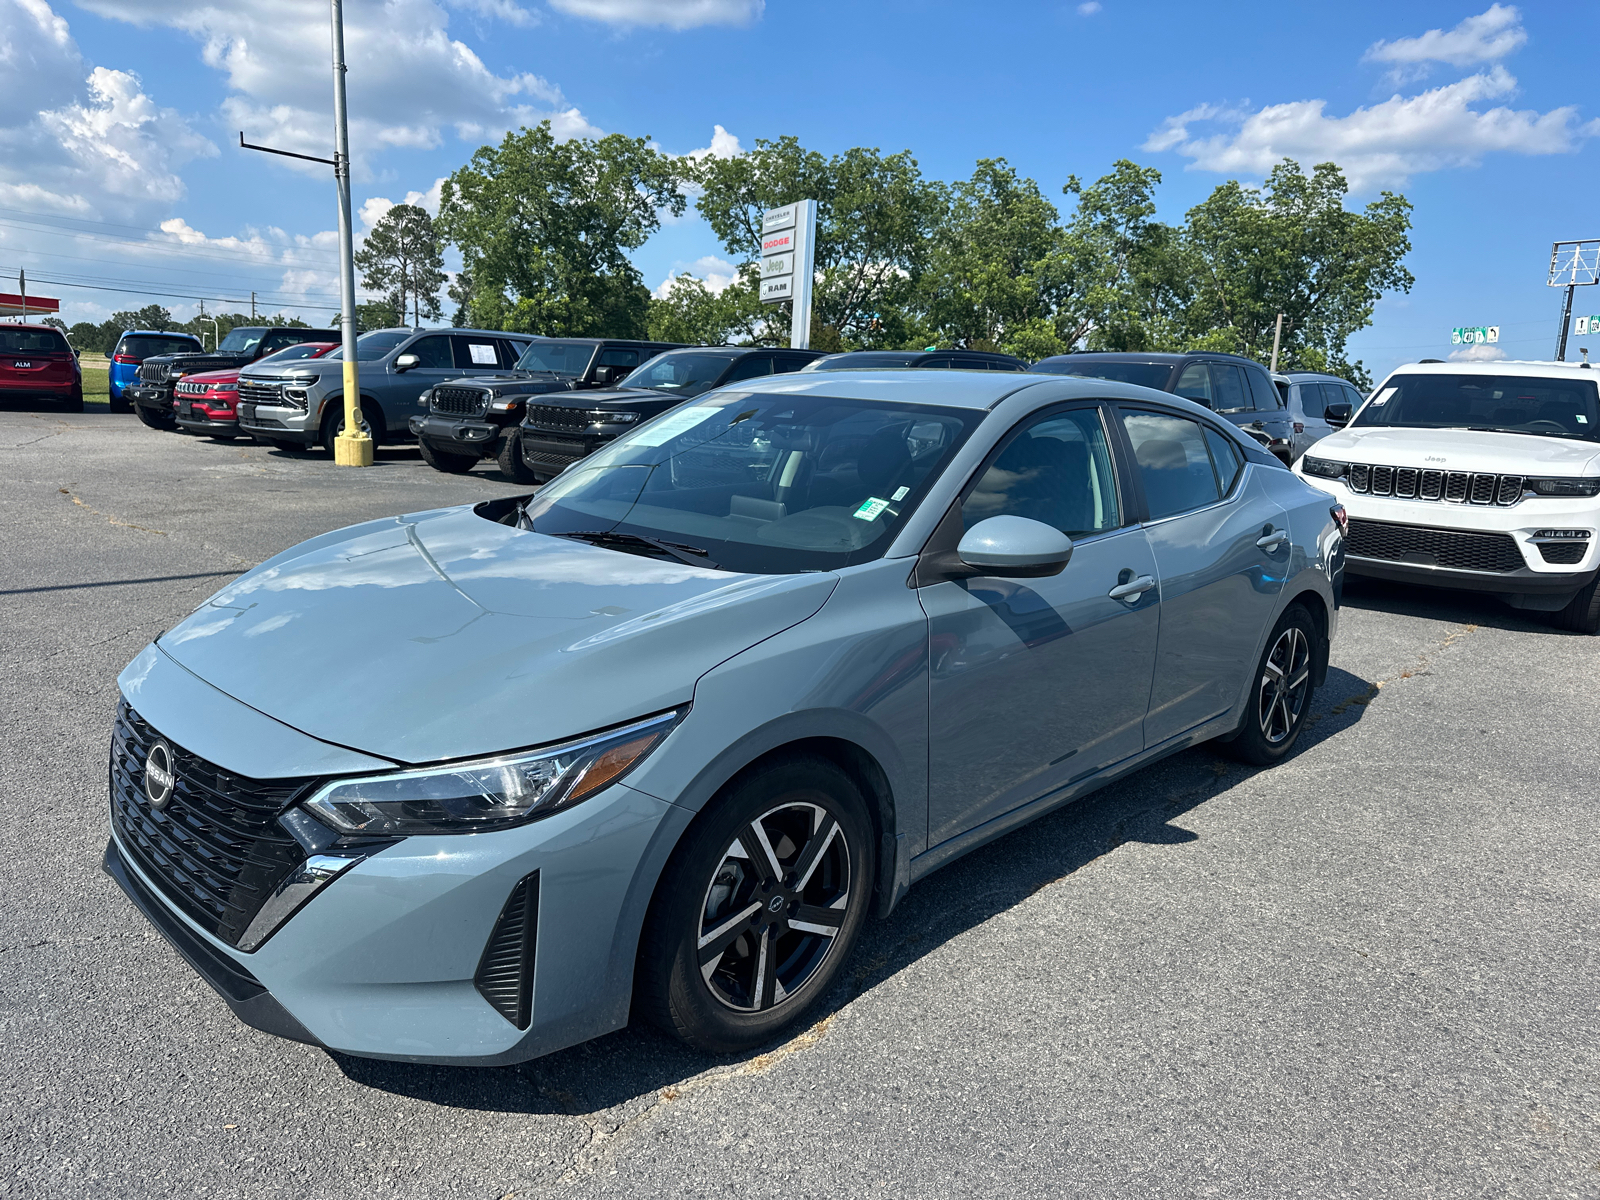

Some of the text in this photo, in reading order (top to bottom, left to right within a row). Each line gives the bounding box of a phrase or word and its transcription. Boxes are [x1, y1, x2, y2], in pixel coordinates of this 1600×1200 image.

[766, 211, 790, 221] CHRYSLER
[763, 236, 790, 250] DODGE
[766, 259, 784, 273] Jeep
[768, 283, 787, 293] RAM
[1424, 455, 1447, 464] Jeep
